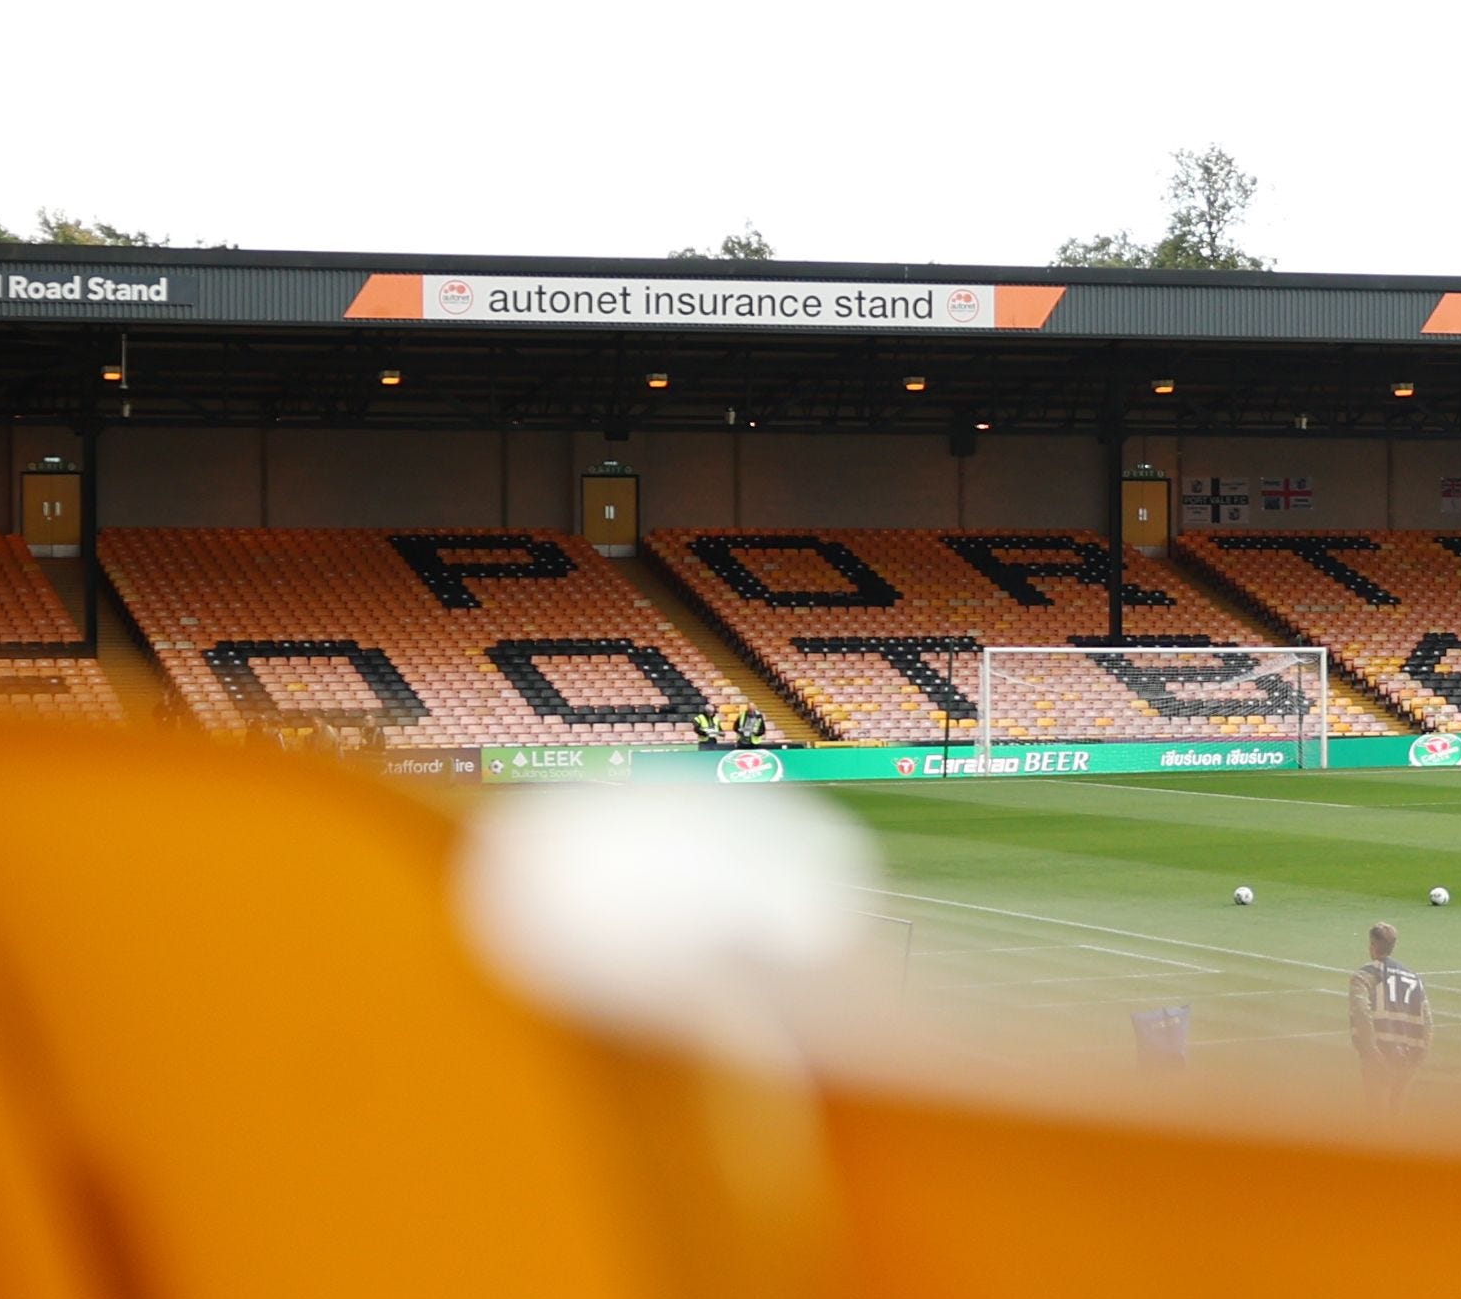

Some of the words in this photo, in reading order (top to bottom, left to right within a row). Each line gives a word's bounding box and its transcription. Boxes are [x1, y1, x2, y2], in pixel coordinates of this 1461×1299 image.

[8, 275, 81, 300] Road
[87, 276, 168, 302] Stand
[488, 284, 632, 314] autonet
[644, 285, 822, 318] insurance
[834, 289, 933, 319] stand
[384, 758, 475, 774] taffordire
[531, 750, 584, 767] LEEK
[1024, 751, 1090, 773] BEER
[1386, 974, 1418, 1004] 17
